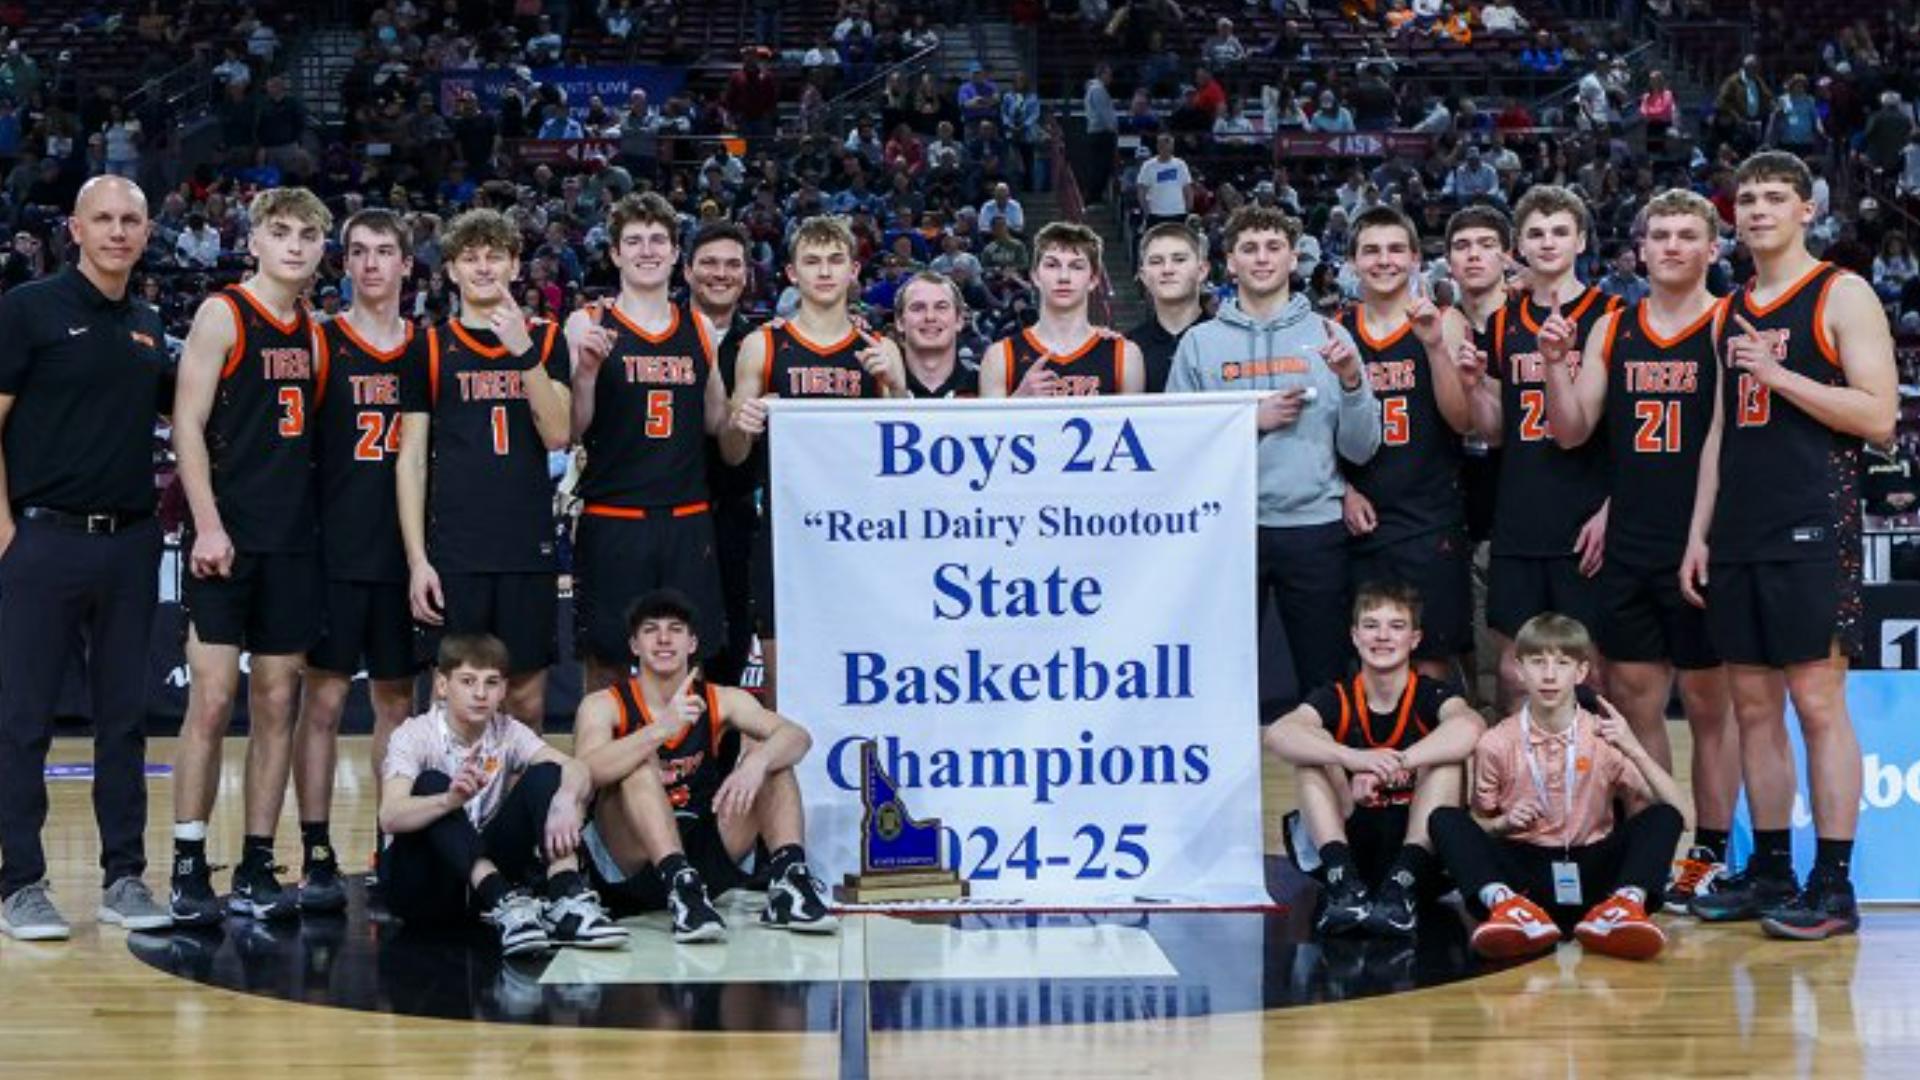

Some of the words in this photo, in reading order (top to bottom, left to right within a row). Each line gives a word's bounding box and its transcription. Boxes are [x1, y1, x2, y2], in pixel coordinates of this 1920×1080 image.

[597, 81, 630, 95] LIVE
[261, 347, 310, 380] TIGER
[456, 369, 530, 401] TIGER
[622, 355, 697, 386] TIGERS
[786, 366, 862, 397] TIGERS
[1056, 374, 1101, 397] GERS
[1366, 357, 1417, 392] GERS
[1623, 360, 1699, 393] TIGERS
[278, 385, 304, 438] 3
[348, 373, 400, 405] TIGE
[644, 388, 675, 439] 5
[1737, 373, 1772, 427] 13
[490, 405, 511, 455] 1
[1382, 397, 1420, 447] 5
[1519, 389, 1551, 442] 2
[1634, 400, 1682, 453] 21
[877, 421, 1037, 491] Boys
[1062, 417, 1154, 472] 2A
[803, 508, 907, 541] “Real
[923, 507, 1025, 546] Dairy
[1039, 501, 1222, 537] Shootout”
[932, 562, 1102, 619] State
[842, 643, 1194, 705] Basketball
[826, 731, 1210, 806] Champions
[939, 823, 1150, 880] 024-25
